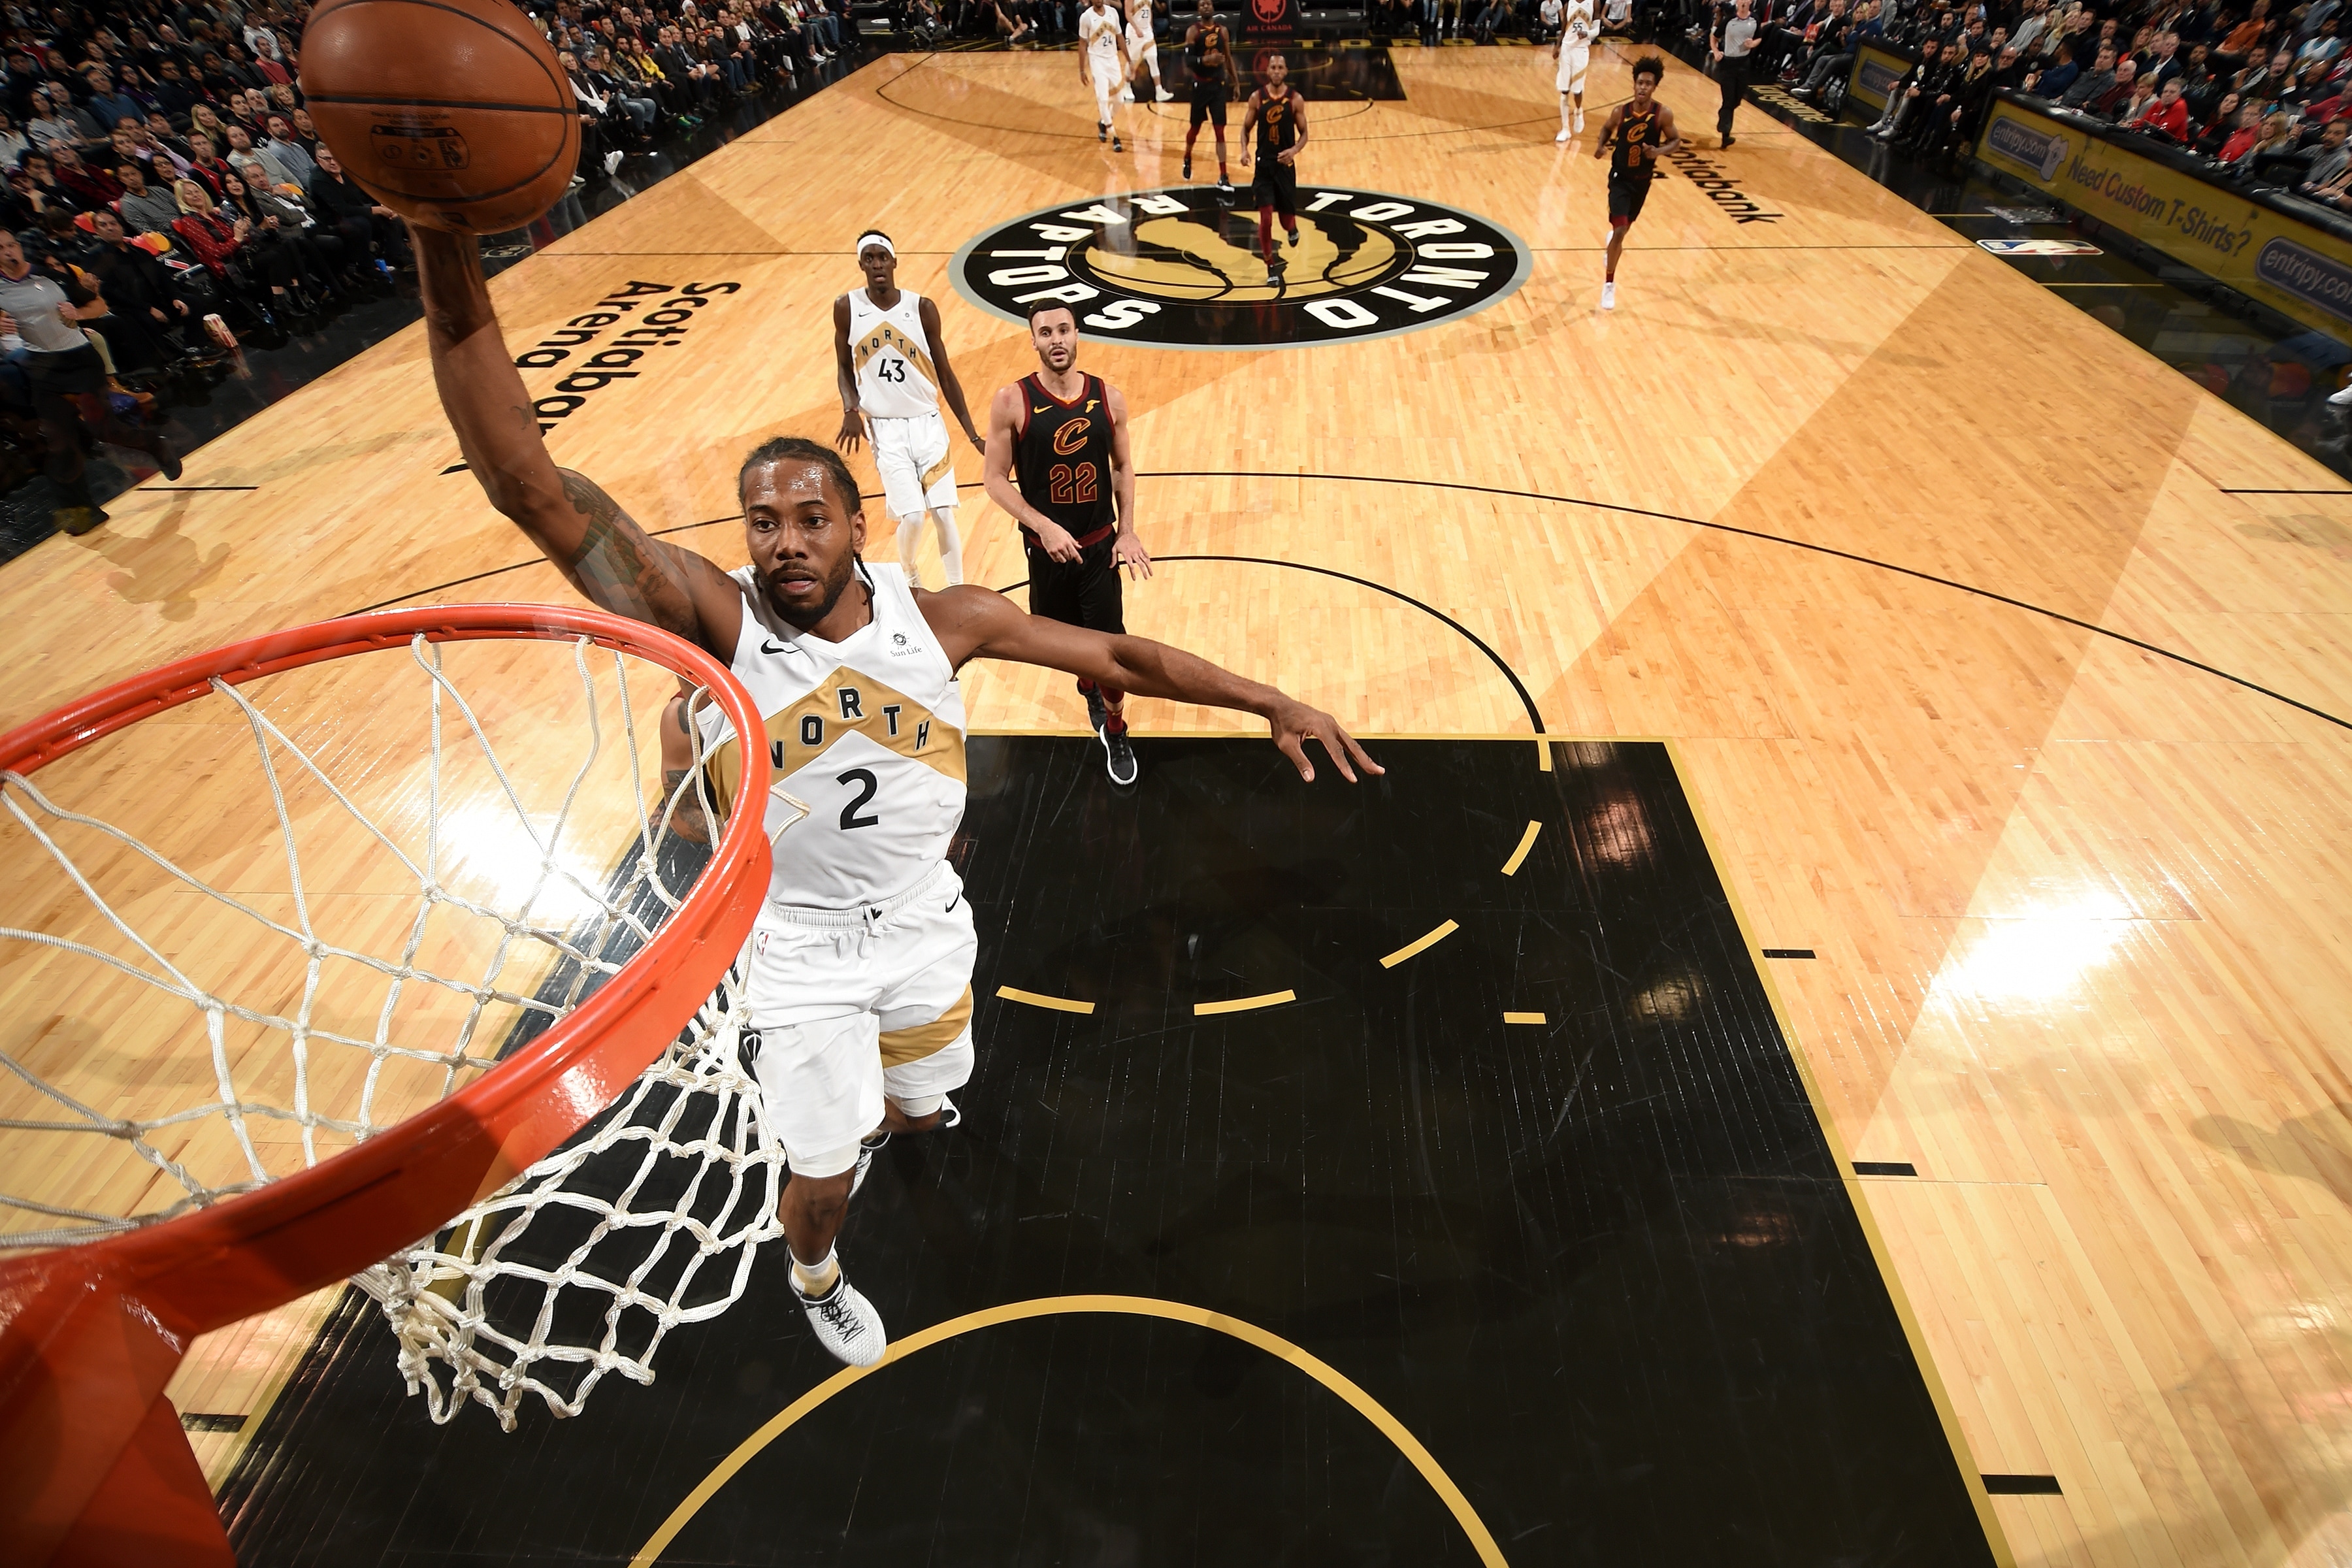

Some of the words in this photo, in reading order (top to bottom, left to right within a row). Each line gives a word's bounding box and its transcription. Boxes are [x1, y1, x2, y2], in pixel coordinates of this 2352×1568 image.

[1266, 105, 1284, 123] C
[1269, 125, 1280, 145] 4
[1627, 123, 1648, 142] C
[1993, 125, 2048, 158] entripy.com
[1627, 144, 1642, 167] 2
[2067, 154, 2109, 191] Need
[2105, 172, 2166, 220] Custom
[2166, 198, 2251, 257] T-Shirts?
[988, 195, 1190, 329] RAPTORS
[1303, 192, 1495, 329] TORONTO
[516, 280, 676, 368] Arena
[861, 329, 916, 358] NORTH
[878, 359, 906, 383] 43
[1054, 417, 1091, 455] C
[1049, 461, 1098, 504] 22
[907, 646, 923, 655] Life
[771, 687, 931, 770] NORTH
[836, 768, 879, 830] 2
